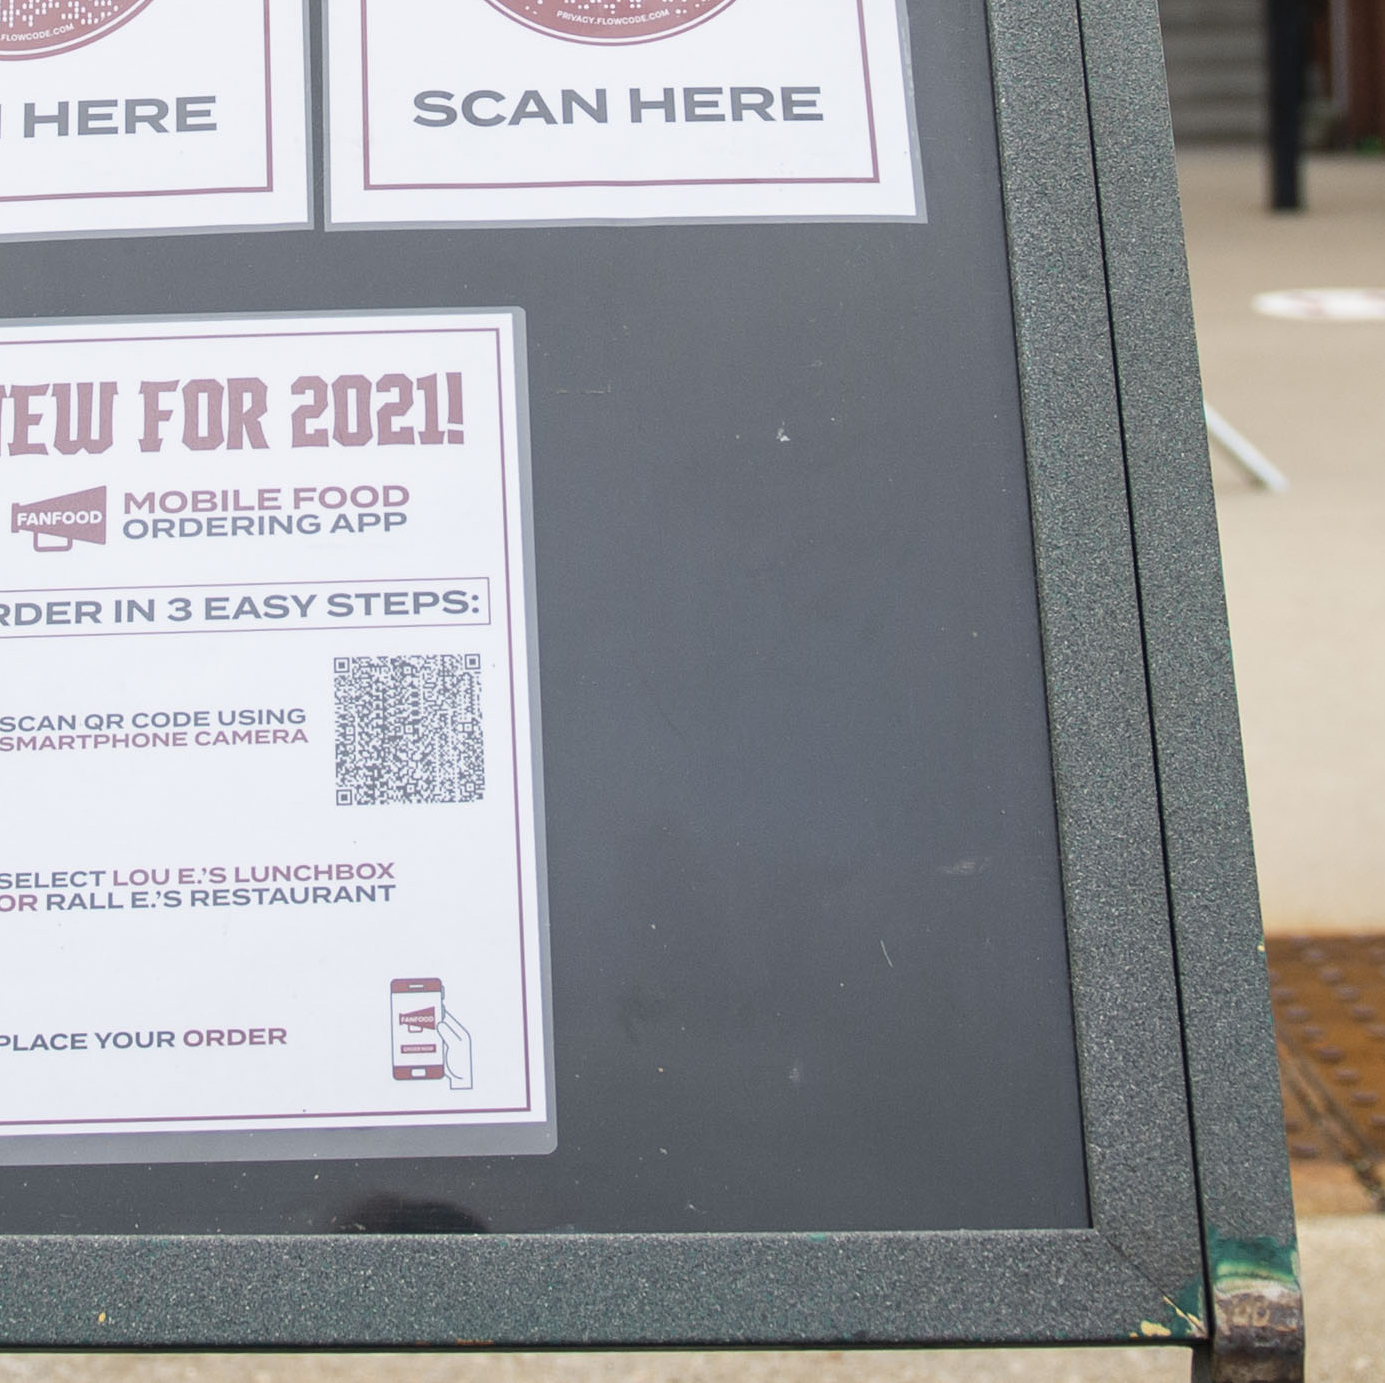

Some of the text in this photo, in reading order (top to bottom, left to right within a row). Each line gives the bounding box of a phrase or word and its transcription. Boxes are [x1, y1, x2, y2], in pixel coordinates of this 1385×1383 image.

[556, 8, 670, 26] PRIVACY.FLOWCODE.COM
[23, 95, 219, 139] HERE
[413, 86, 825, 128] SCAN HERE
[138, 376, 271, 454] FOR
[290, 371, 465, 448] 2021!
[123, 484, 411, 514] MOBILE FOOD
[16, 510, 103, 526] FANFOOD
[122, 511, 409, 540] ORDERING APP
[114, 598, 156, 624] IN
[166, 596, 193, 622] 3
[204, 594, 318, 621] EASY
[326, 589, 481, 618] STEPS:
[84, 713, 124, 731] QR
[131, 711, 211, 728] CODE
[217, 708, 307, 725] USING
[194, 728, 310, 746] CAMERA
[113, 868, 170, 887] LOU
[234, 862, 396, 882] LUNCHBOX
[46, 891, 124, 911] RALL
[190, 885, 396, 906] RESTAURANT
[94, 1030, 176, 1048] YOUR
[183, 1028, 288, 1047] ORDER
